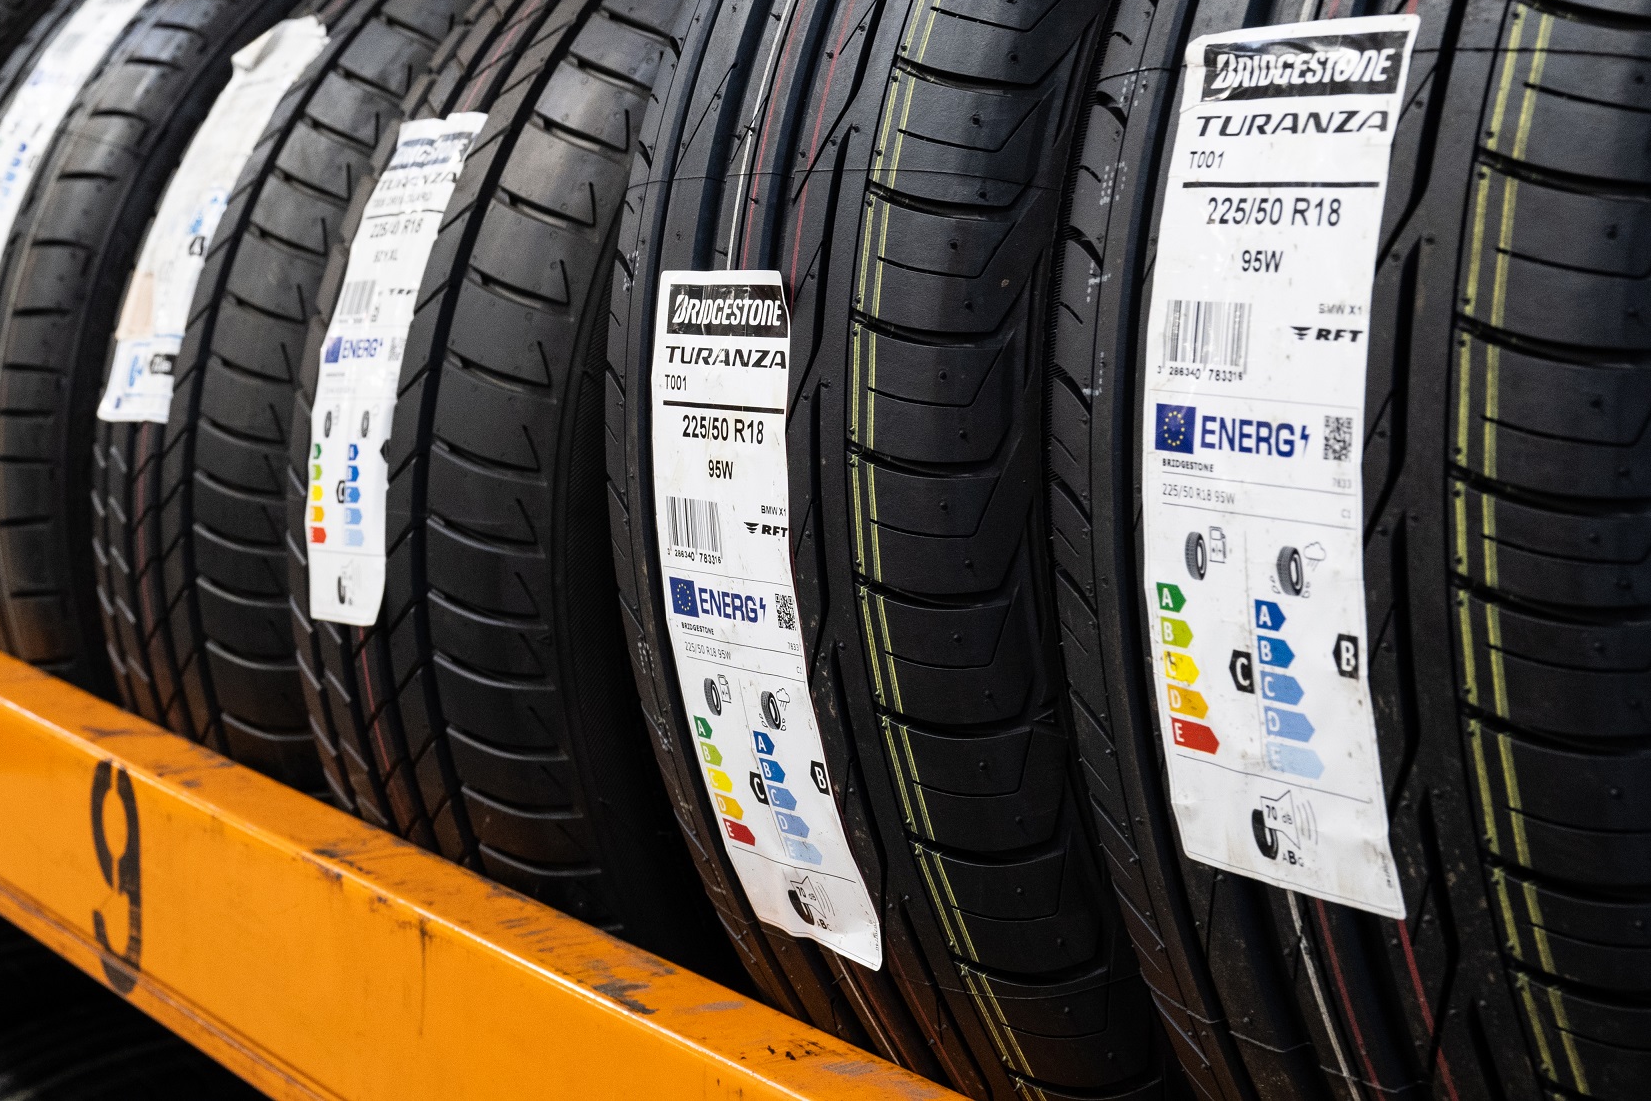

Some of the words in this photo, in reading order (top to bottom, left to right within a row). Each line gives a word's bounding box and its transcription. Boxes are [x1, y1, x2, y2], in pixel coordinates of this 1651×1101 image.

[1211, 49, 1395, 89] BRIDGESTONE
[1197, 110, 1388, 136] TURANZA
[1189, 151, 1224, 169] T001
[1206, 197, 1283, 226] 225/50
[1291, 197, 1341, 227] R18
[1242, 249, 1283, 272] 95W
[672, 295, 782, 326] BRIDGESTONE
[1315, 328, 1364, 342] RFT
[665, 346, 787, 369] TURANZA
[665, 374, 687, 390] T001
[682, 414, 729, 442] 225/50
[735, 418, 764, 444] R18
[1200, 415, 1296, 458] ENERG
[708, 459, 734, 480] 95W
[1162, 458, 1214, 472] BRIDGESTONE
[1162, 484, 1194, 499] 225/50
[1196, 488, 1212, 502] R18
[1215, 490, 1235, 505] 95W
[761, 505, 778, 516] BMW
[761, 524, 788, 537] RFT
[698, 587, 759, 623] ENERG
[1162, 589, 1173, 608] A
[1259, 605, 1272, 627] A
[681, 622, 714, 635] BRIDGESTONE
[1163, 622, 1174, 641] B
[1260, 642, 1272, 661] B
[1341, 641, 1355, 671] B
[1236, 657, 1250, 686] C
[1264, 677, 1276, 697] C
[1170, 689, 1182, 709] D
[698, 724, 706, 736] A
[1267, 712, 1280, 731] D
[1174, 722, 1185, 742] E
[757, 736, 766, 750] A
[703, 748, 712, 760] B
[764, 763, 772, 777] B
[815, 768, 826, 789] B
[753, 778, 765, 799] C
[770, 790, 780, 804] C
[718, 798, 726, 811] D
[1265, 804, 1278, 821] 70
[726, 824, 733, 837] E
[778, 817, 788, 830] D
[91, 758, 143, 995] 9
